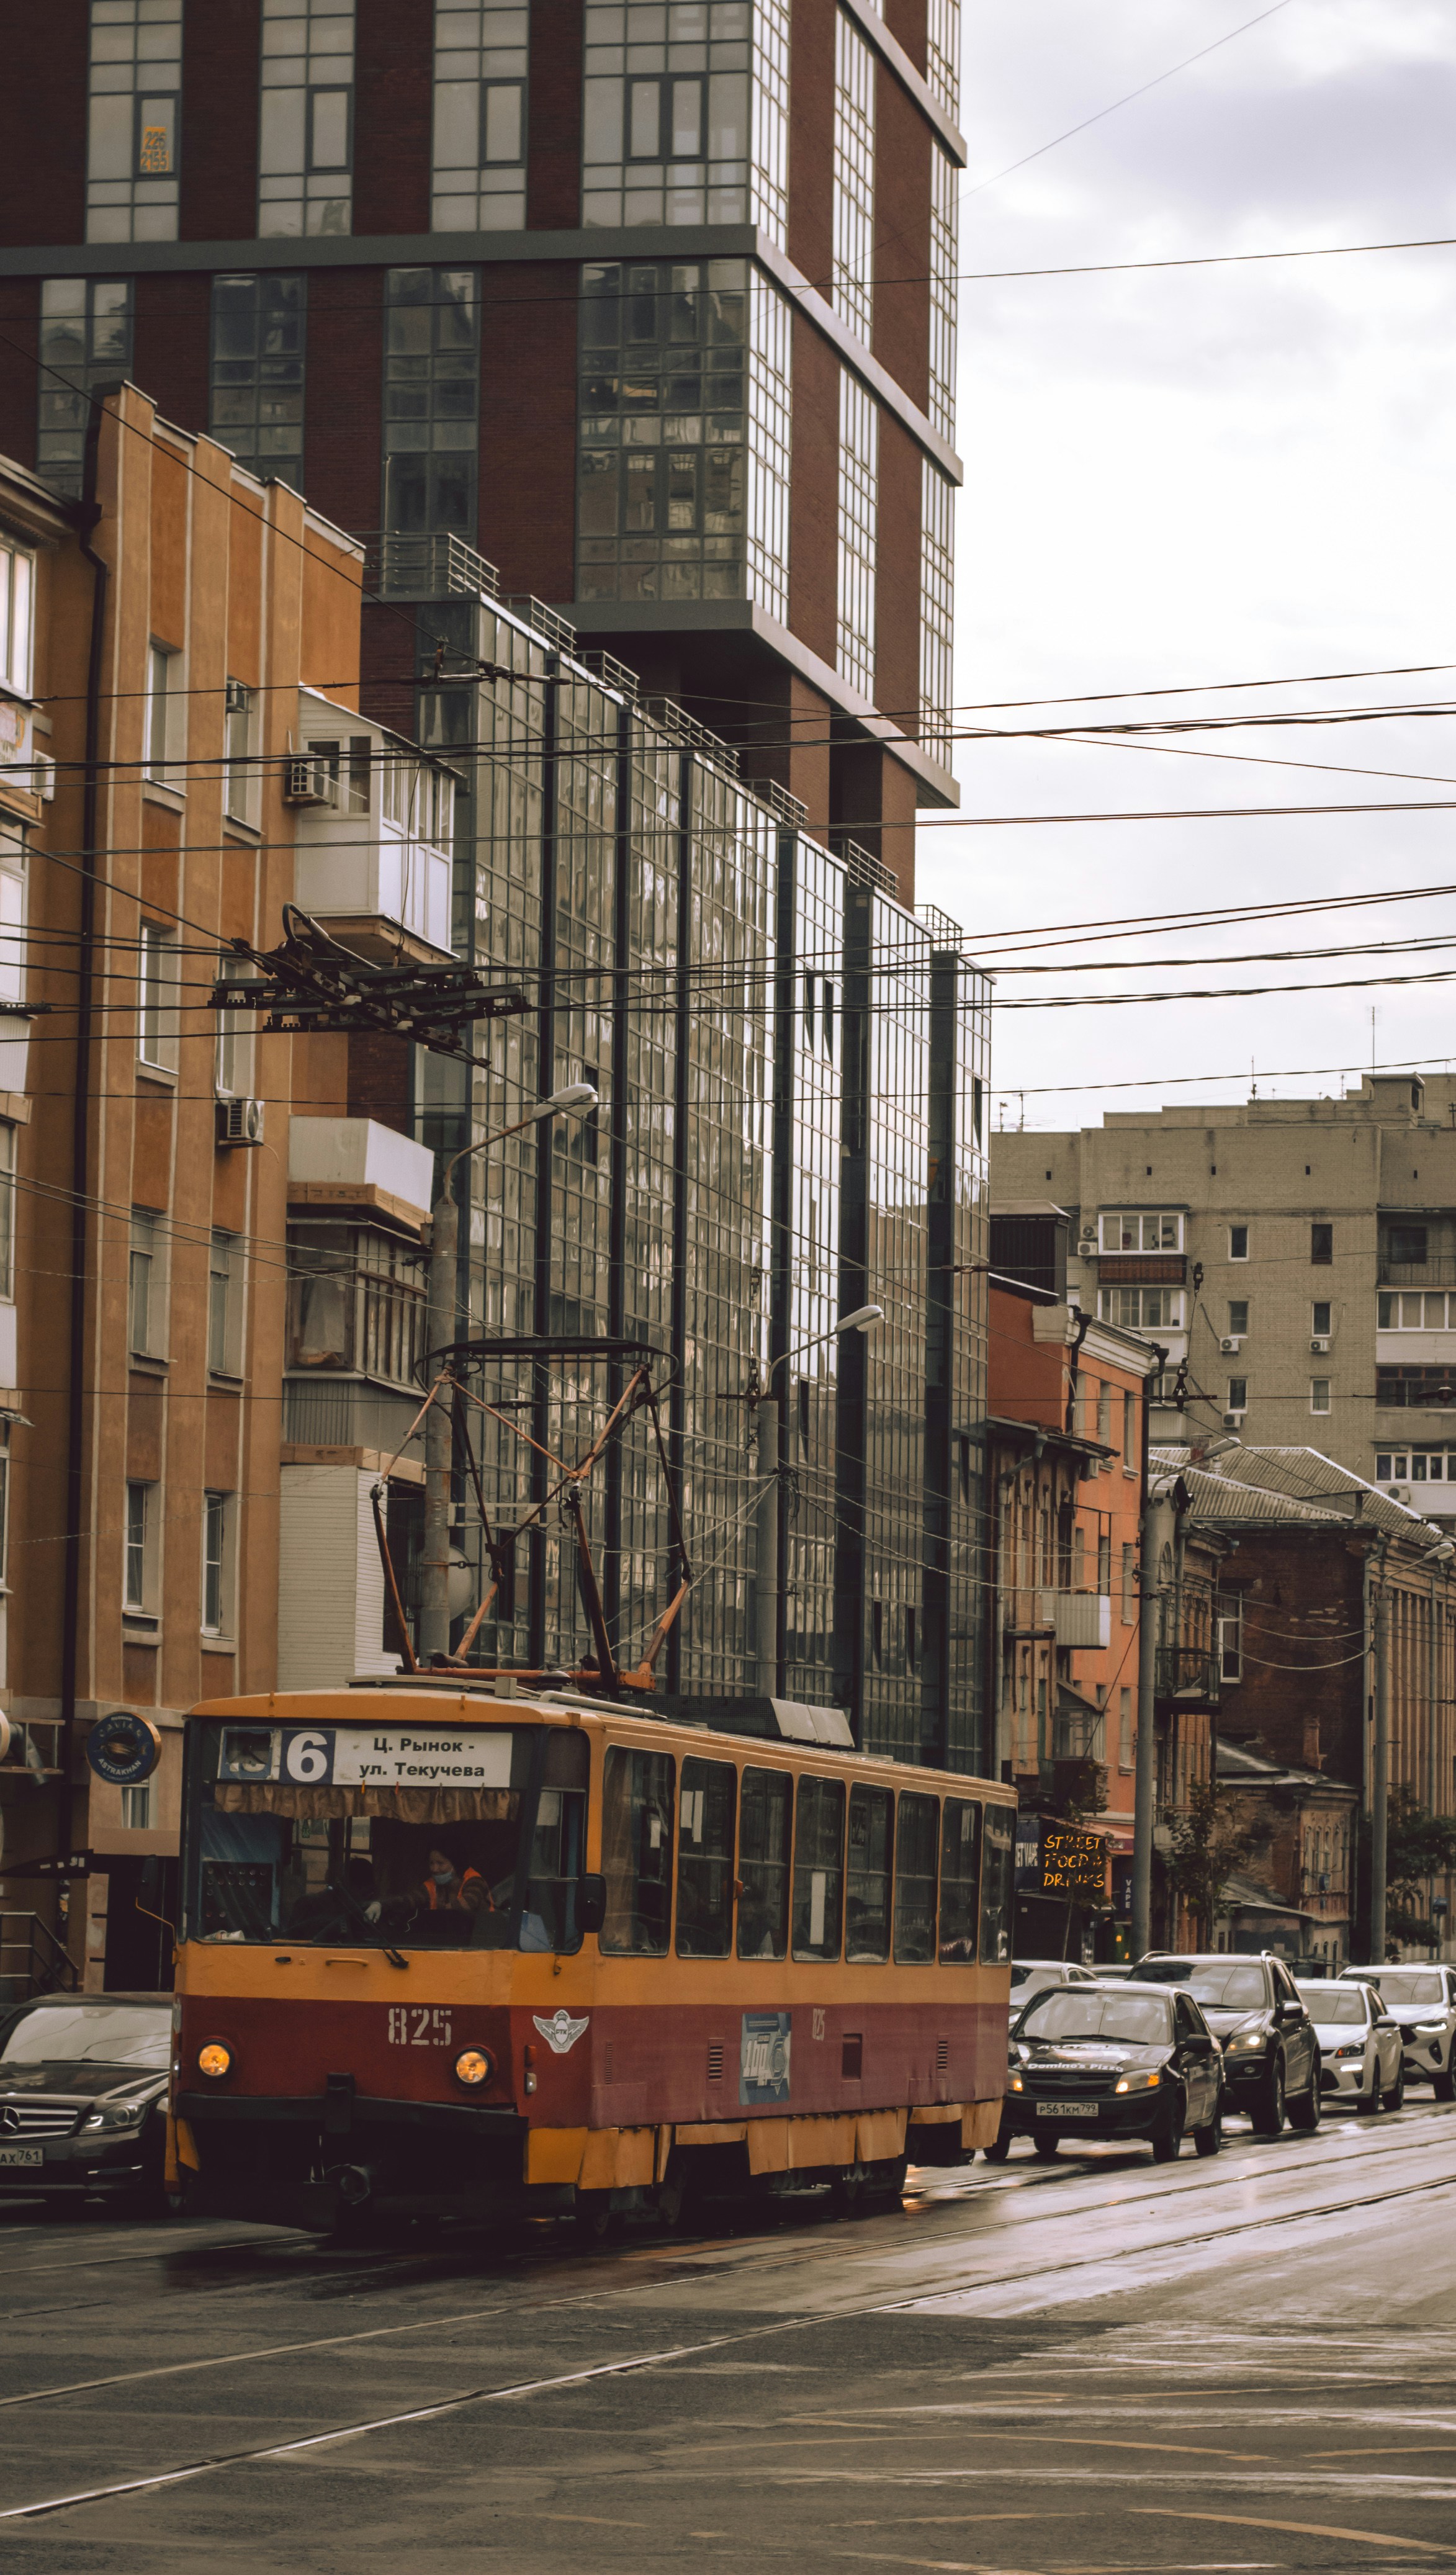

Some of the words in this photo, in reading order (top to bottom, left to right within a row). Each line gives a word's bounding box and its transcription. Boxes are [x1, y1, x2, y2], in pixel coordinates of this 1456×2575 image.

[374, 1737, 393, 1753] Ц.
[400, 1738, 462, 1752] Рынок
[287, 1732, 327, 1782] 6
[97, 1758, 142, 1775] ASTRAKHAN
[359, 1764, 387, 1777] ул.
[394, 1762, 485, 1779] Текучева
[389, 2008, 452, 2046] 825
[1089, 2064, 1124, 2073] Pizza
[19, 2150, 39, 2160] 761
